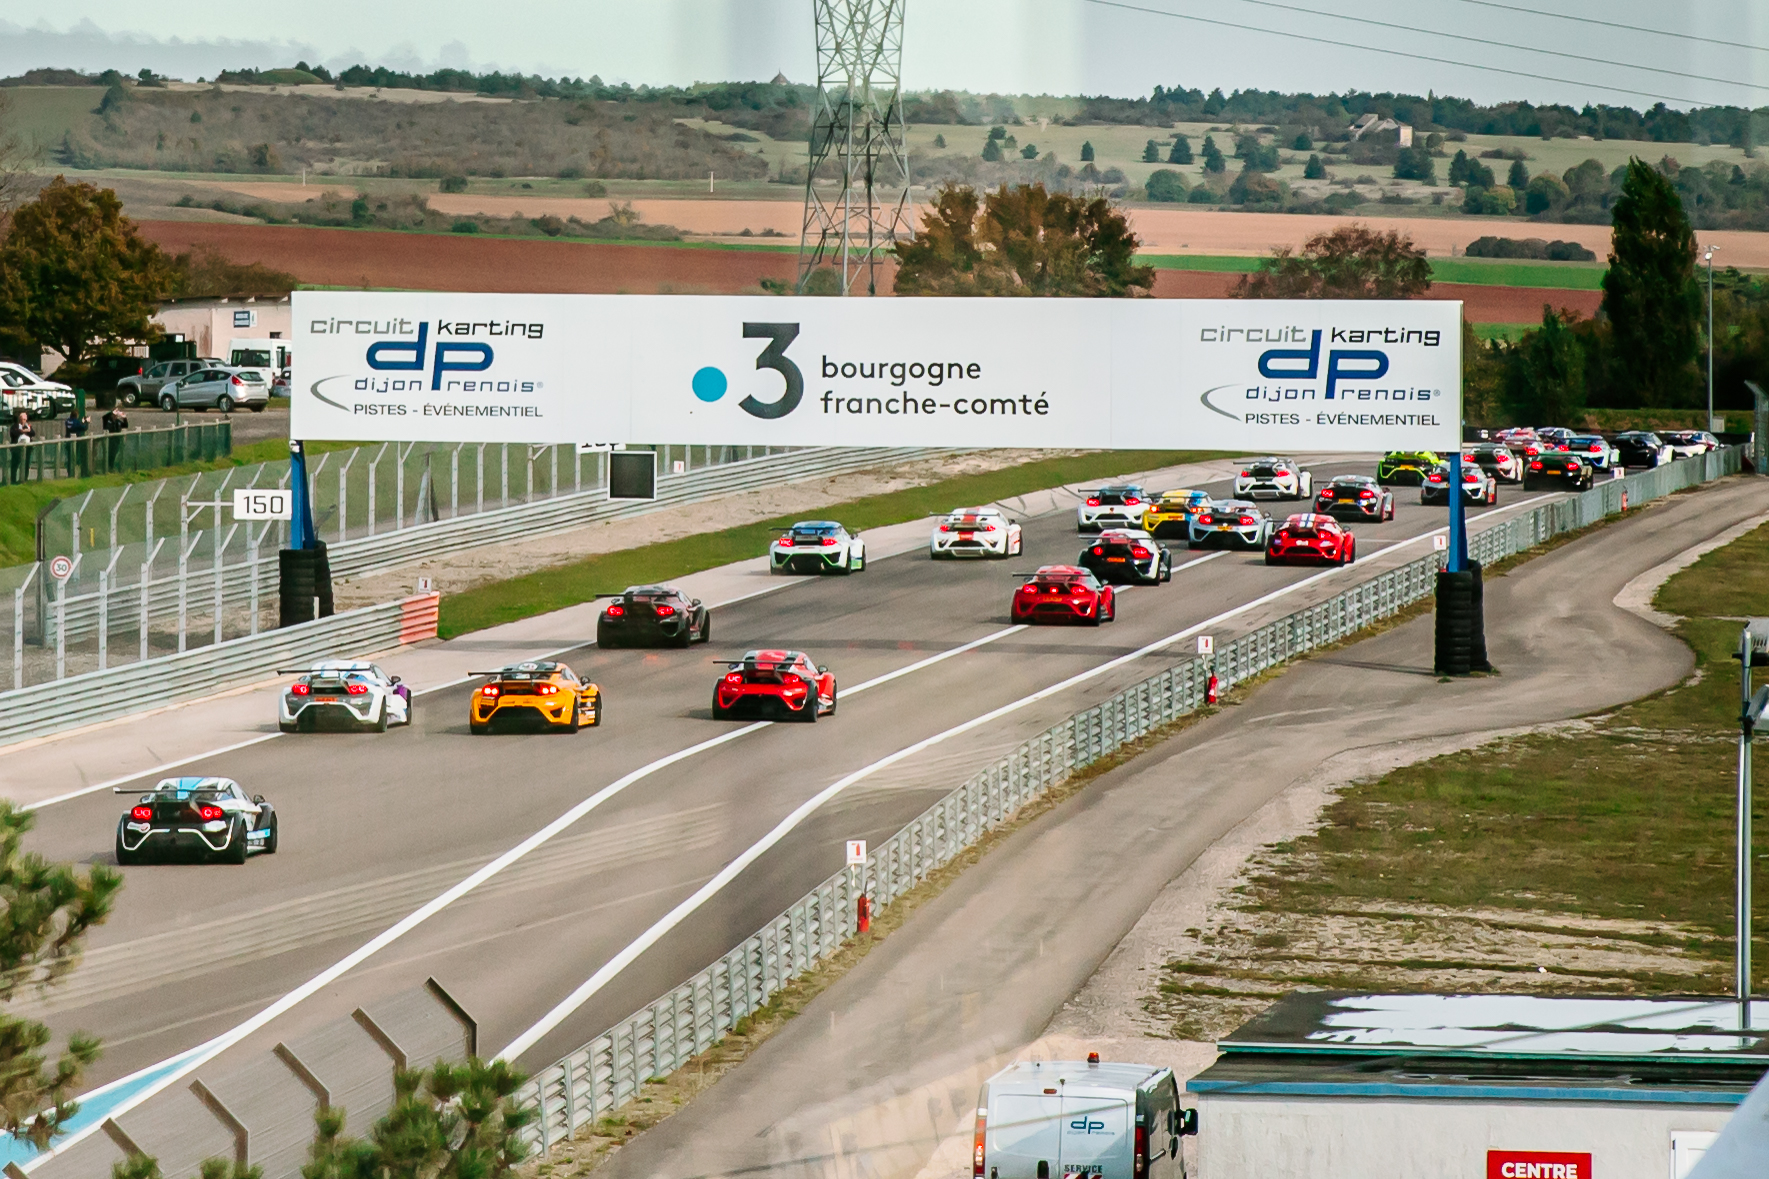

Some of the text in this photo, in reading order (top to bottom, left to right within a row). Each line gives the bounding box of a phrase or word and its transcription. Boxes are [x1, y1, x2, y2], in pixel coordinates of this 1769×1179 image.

[310, 317, 544, 339] circuit karting
[1200, 325, 1441, 346] circuit karting
[366, 322, 494, 391] dp
[1257, 329, 1389, 400] dp
[738, 322, 804, 419] 3
[822, 355, 981, 386] bourgogne
[354, 377, 422, 393] dijon
[1246, 386, 1315, 402] dijon
[354, 403, 407, 415] PISTES
[423, 402, 543, 417] ÉVÉNEMENTIEL
[820, 390, 1049, 415] franche-comté
[1245, 413, 1300, 425] PISTES
[1317, 411, 1441, 426] ÉVÉNEMENTIEL
[243, 495, 284, 514] 150
[1070, 1116, 1105, 1134] dp
[1064, 1164, 1103, 1173] SERVICE
[1501, 1162, 1578, 1179] CENTRE
